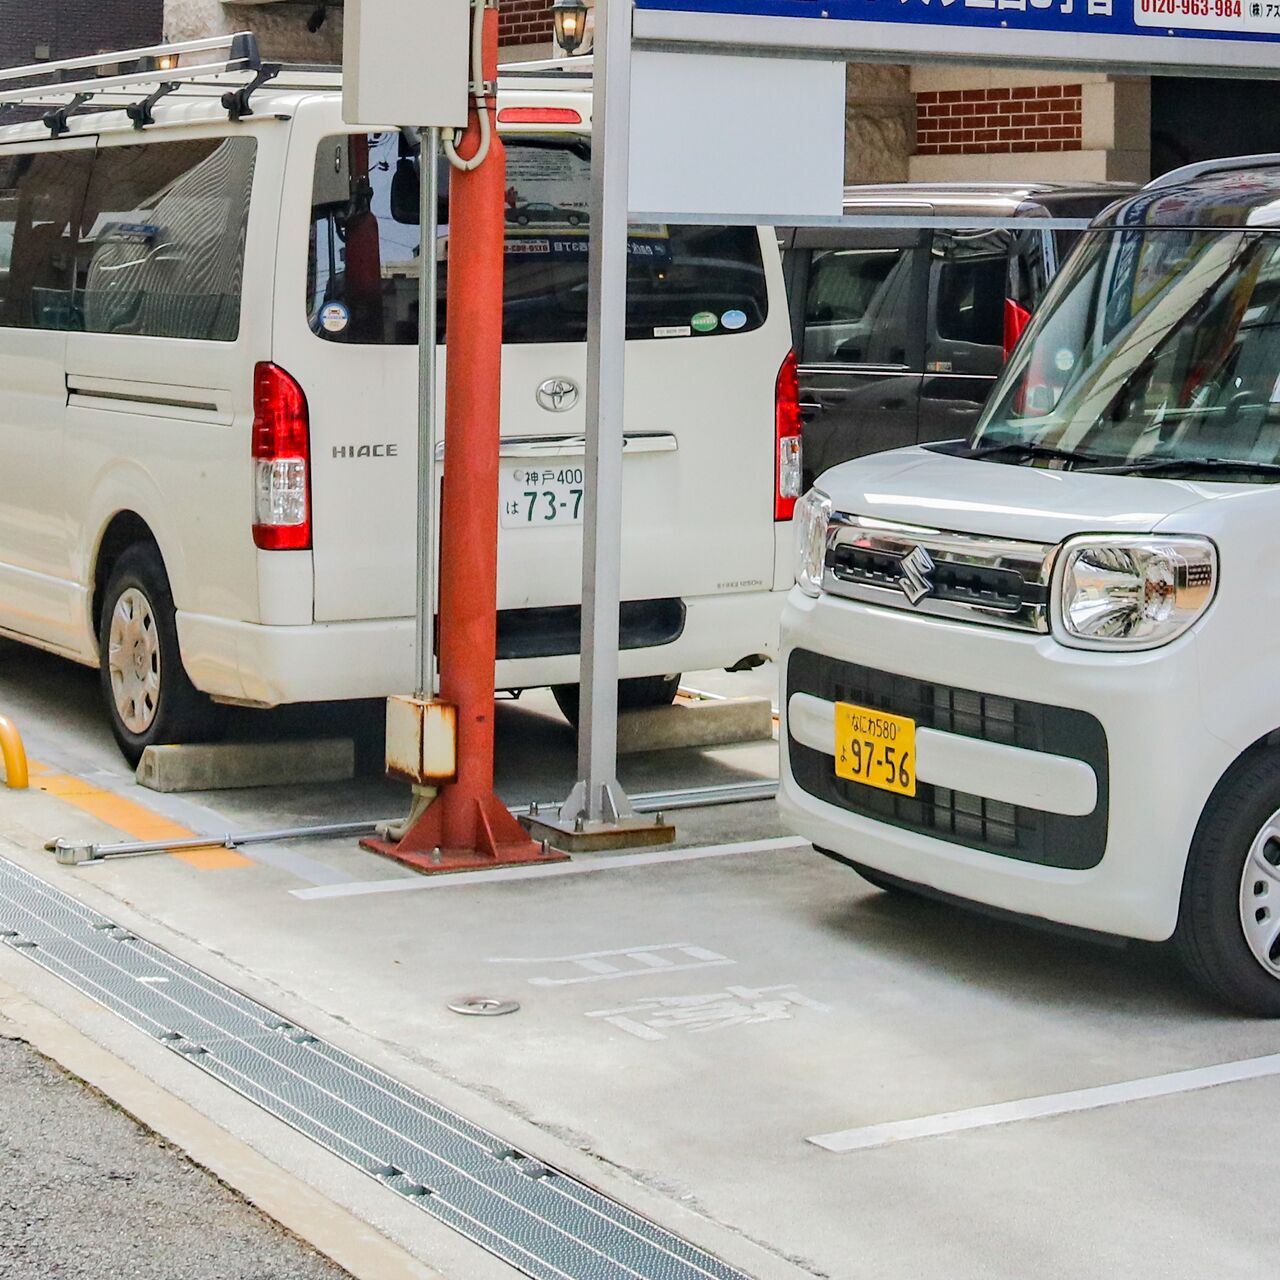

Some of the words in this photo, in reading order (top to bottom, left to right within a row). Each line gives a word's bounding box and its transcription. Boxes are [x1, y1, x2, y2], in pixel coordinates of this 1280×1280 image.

[332, 443, 399, 459] HIACE
[506, 501, 520, 516] は
[523, 489, 584, 522] 73-7
[851, 738, 910, 788] 97-56
